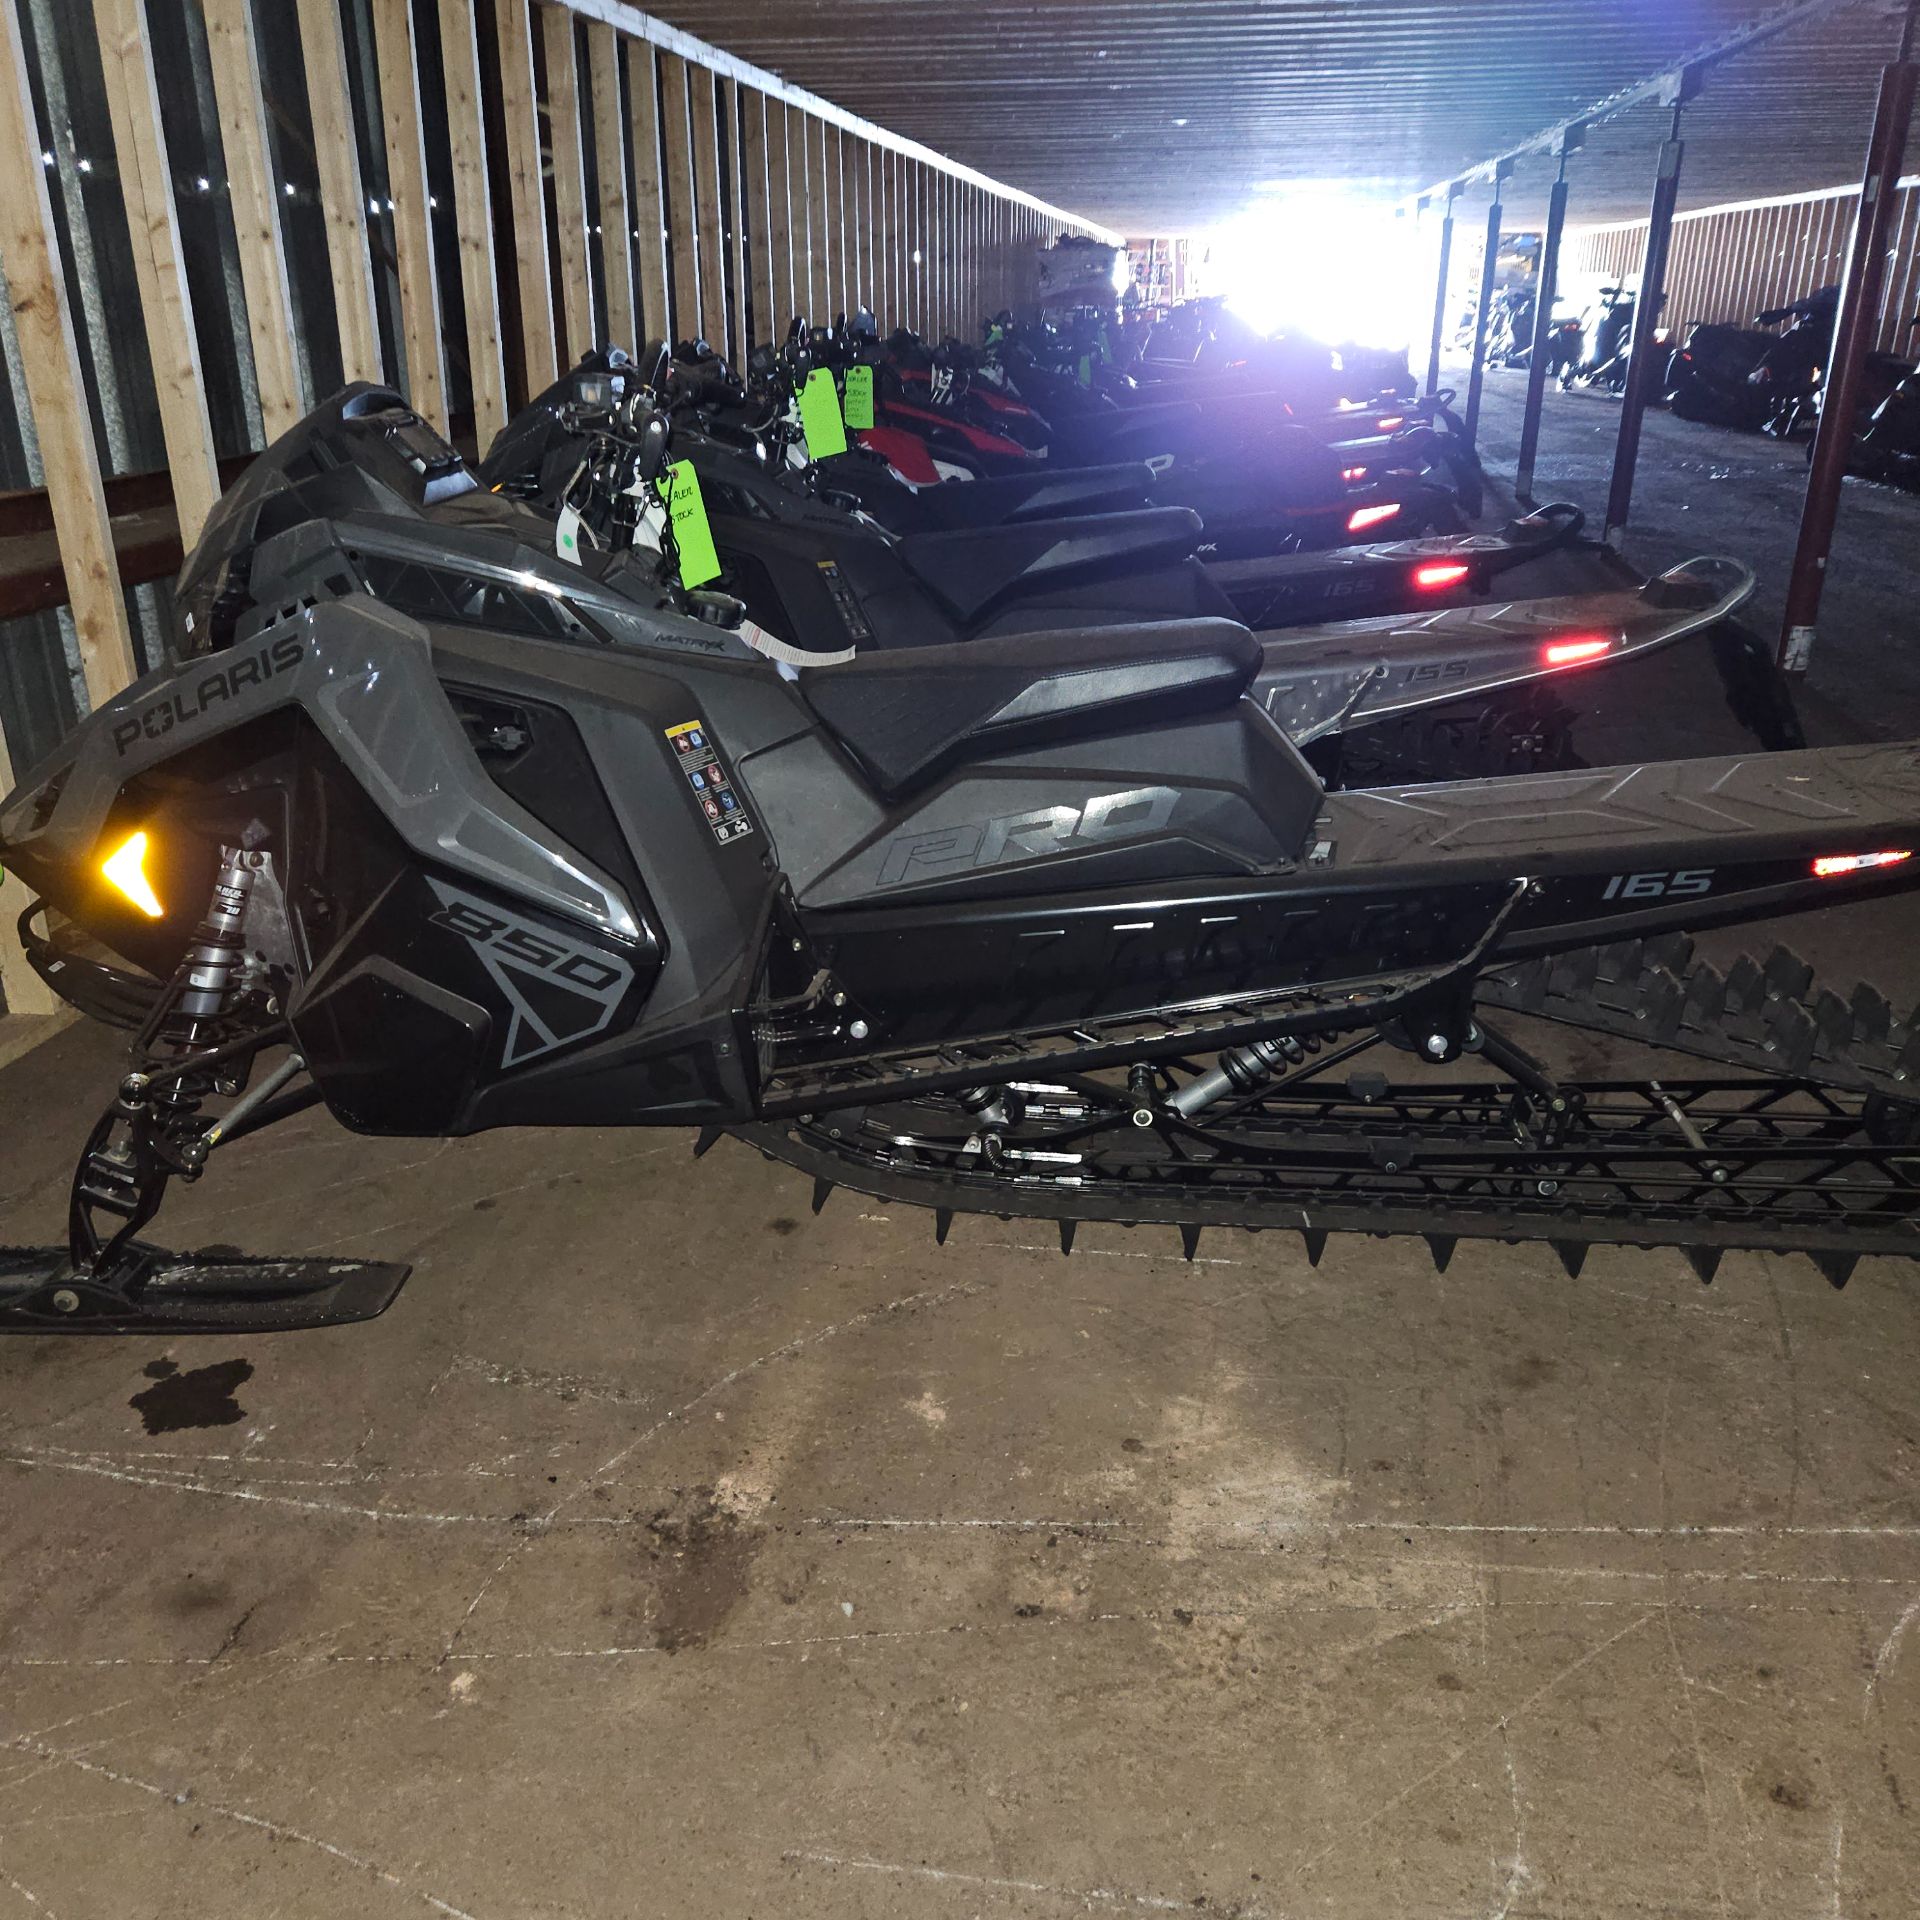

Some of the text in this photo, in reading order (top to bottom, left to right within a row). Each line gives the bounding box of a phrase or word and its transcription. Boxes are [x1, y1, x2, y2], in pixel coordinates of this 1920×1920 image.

[654, 632, 726, 652] MATRYX
[1404, 659, 1469, 683] 155
[112, 633, 304, 758] POLARIS
[876, 785, 1183, 886] PRO
[1602, 868, 1716, 900] 165
[428, 901, 622, 992] 850
